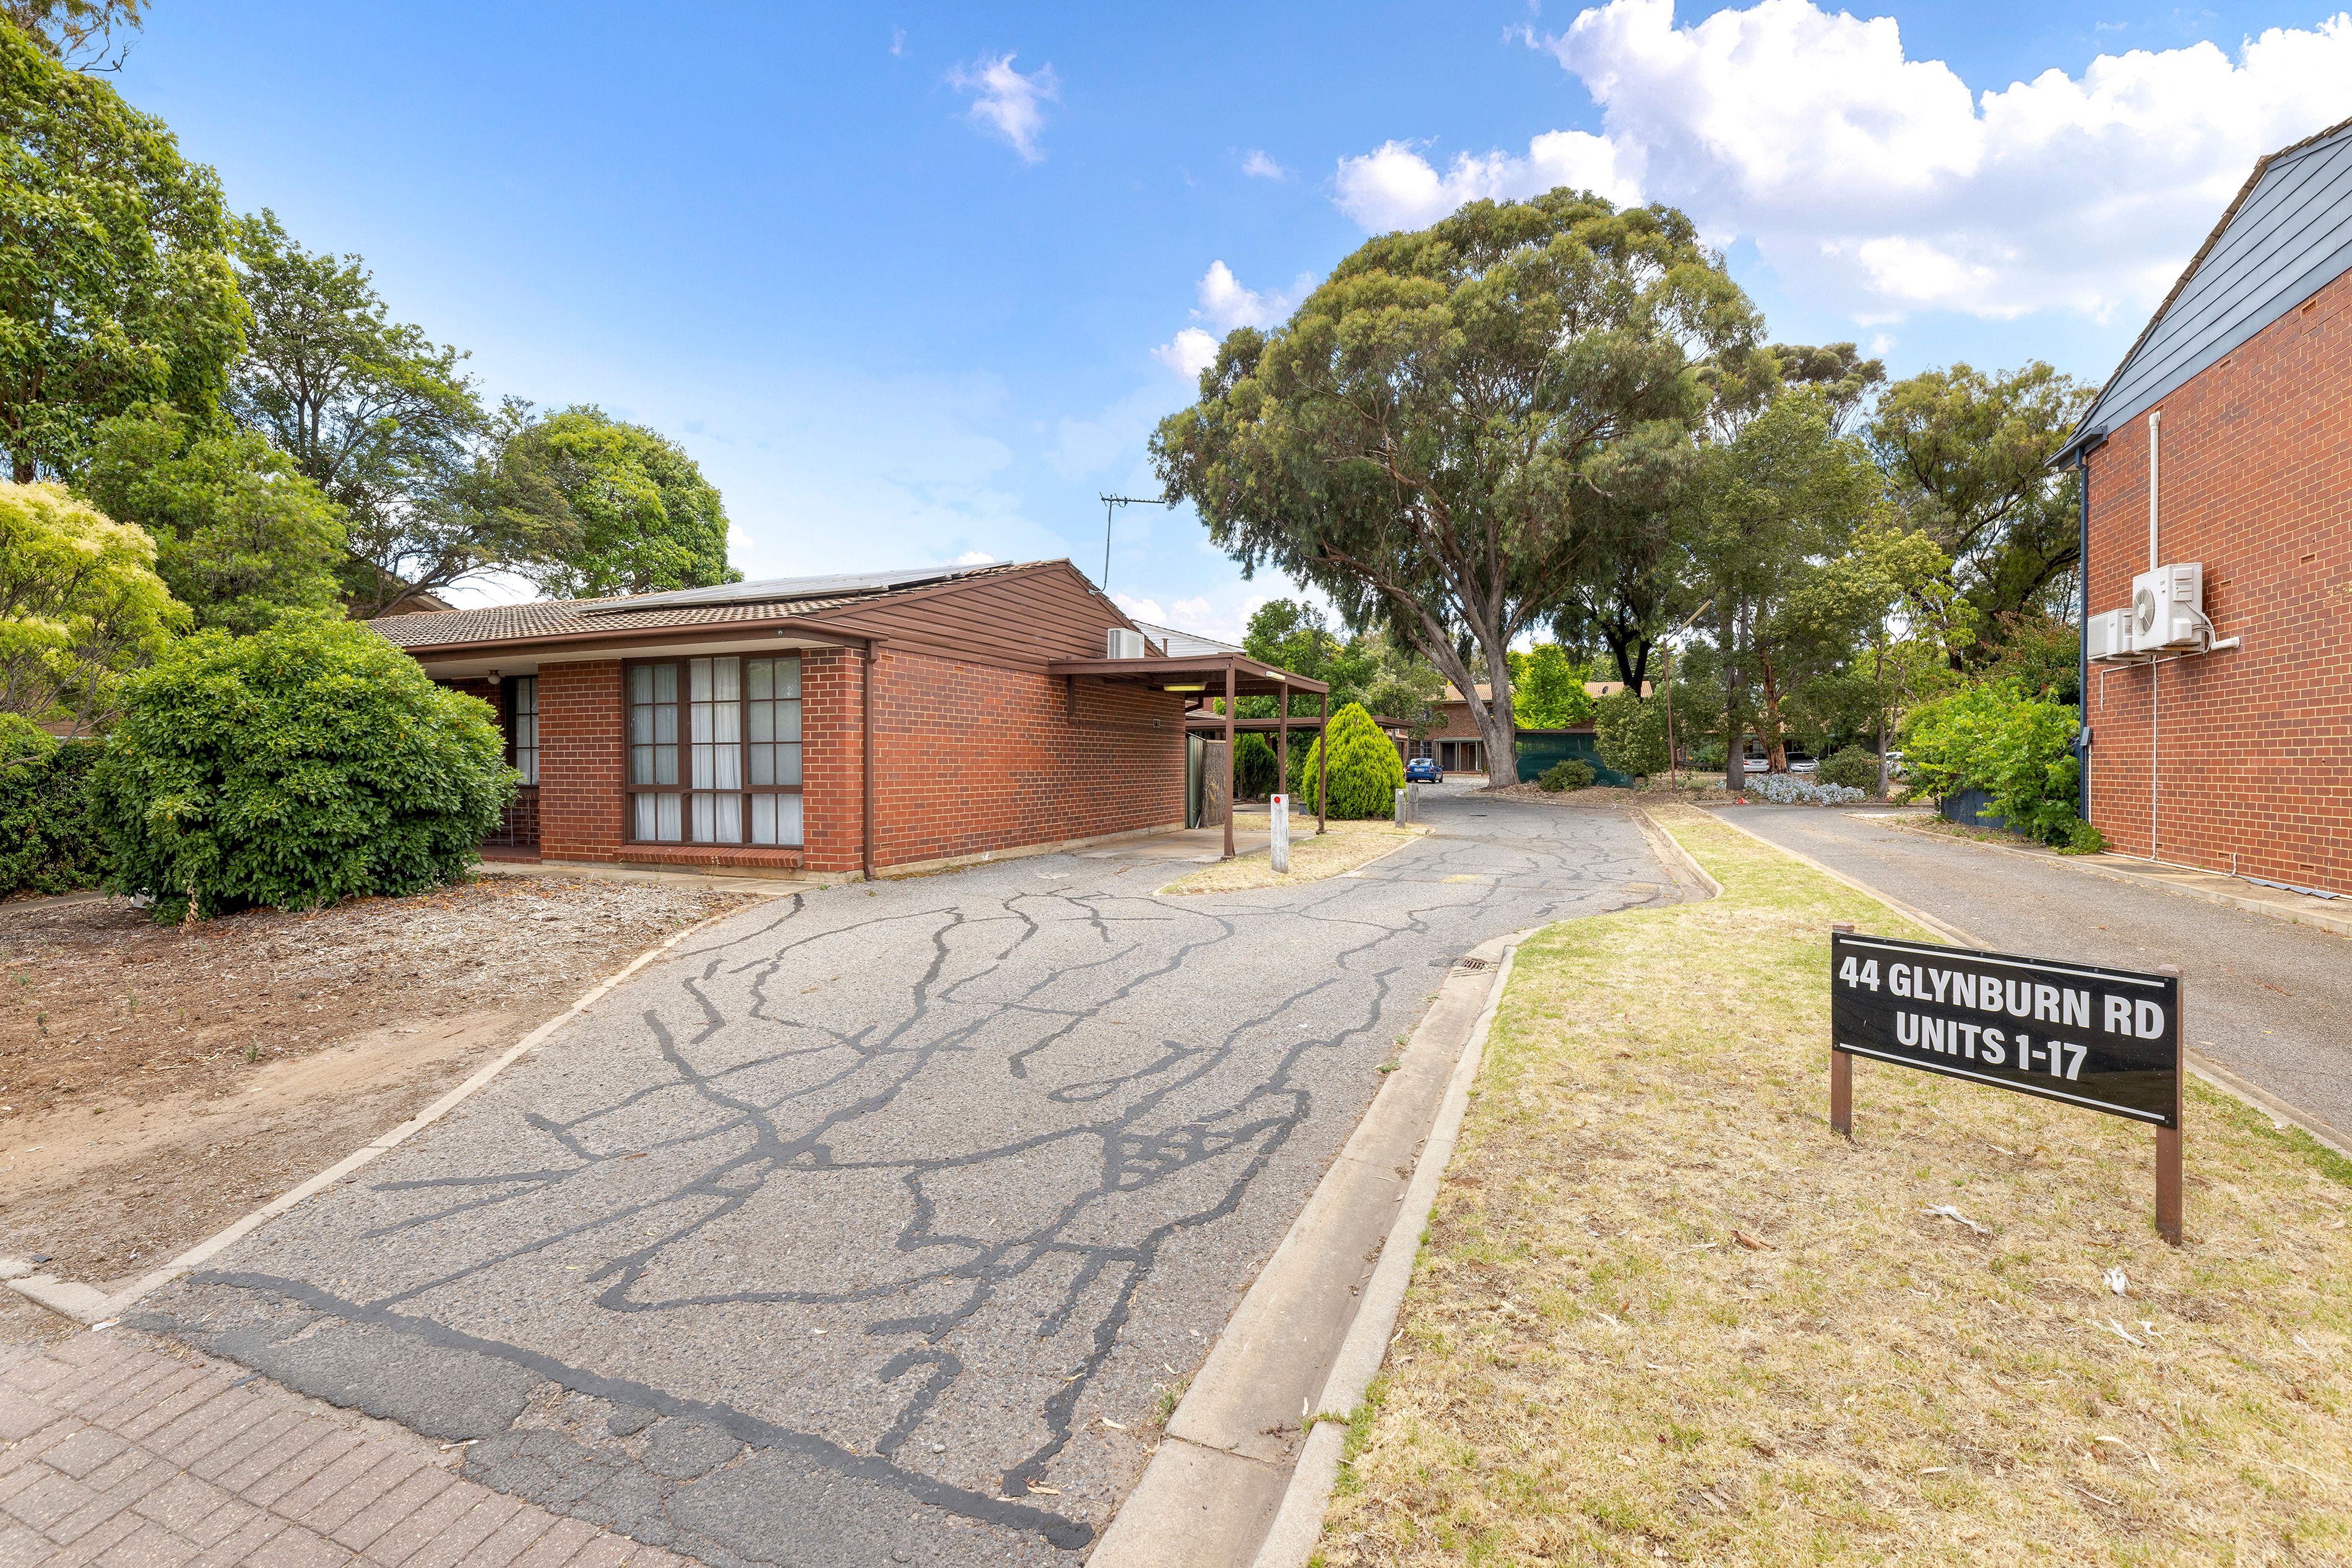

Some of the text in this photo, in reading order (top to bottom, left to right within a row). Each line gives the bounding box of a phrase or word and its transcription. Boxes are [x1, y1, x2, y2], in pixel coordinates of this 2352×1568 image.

[1839, 956, 2165, 1040] 44 GLYNBURN RD
[1896, 1011, 2088, 1081] UNITS 1-17
